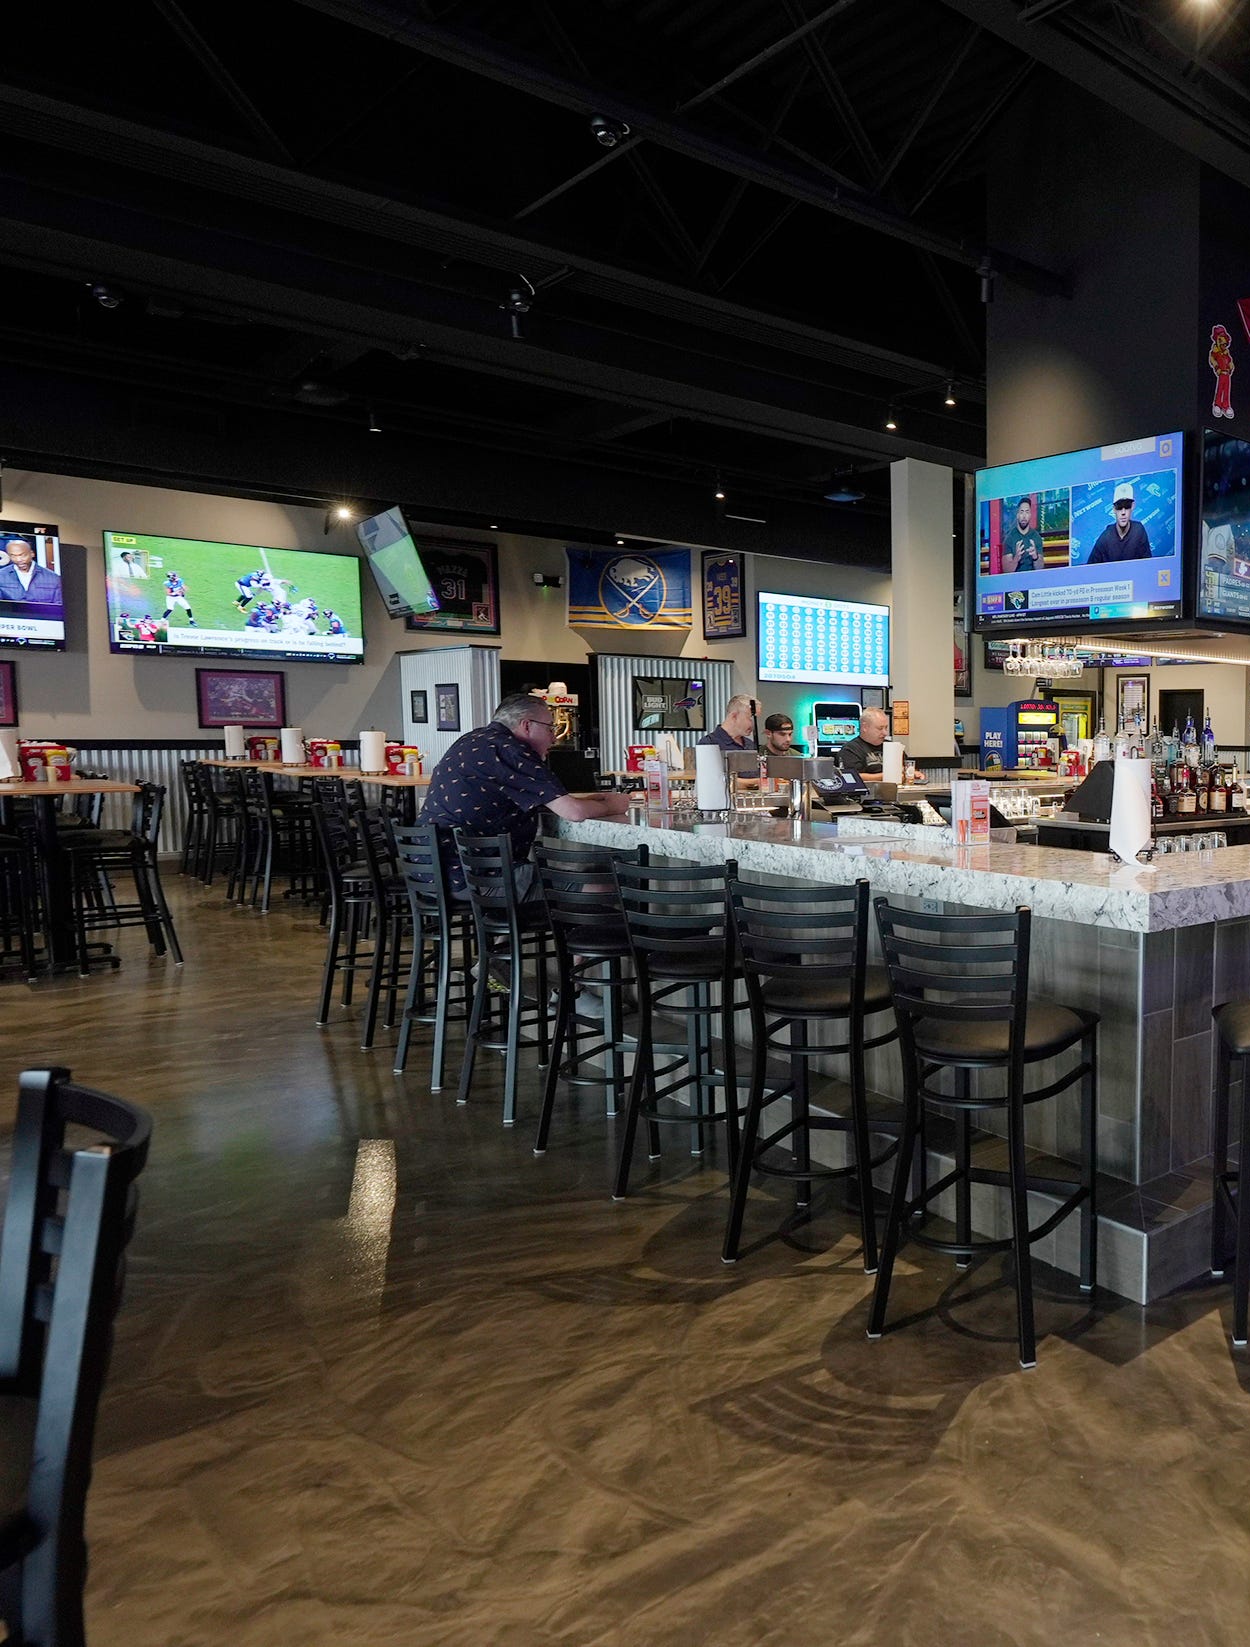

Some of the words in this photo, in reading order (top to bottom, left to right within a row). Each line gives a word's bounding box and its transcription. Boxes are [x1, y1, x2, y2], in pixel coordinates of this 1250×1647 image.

[1222, 578, 1241, 587] PADRES
[441, 578, 465, 600] 31
[714, 585, 731, 615] 39
[643, 701, 667, 709] LIGHT
[985, 731, 1002, 740] PLAY
[984, 740, 1003, 748] HERE!
